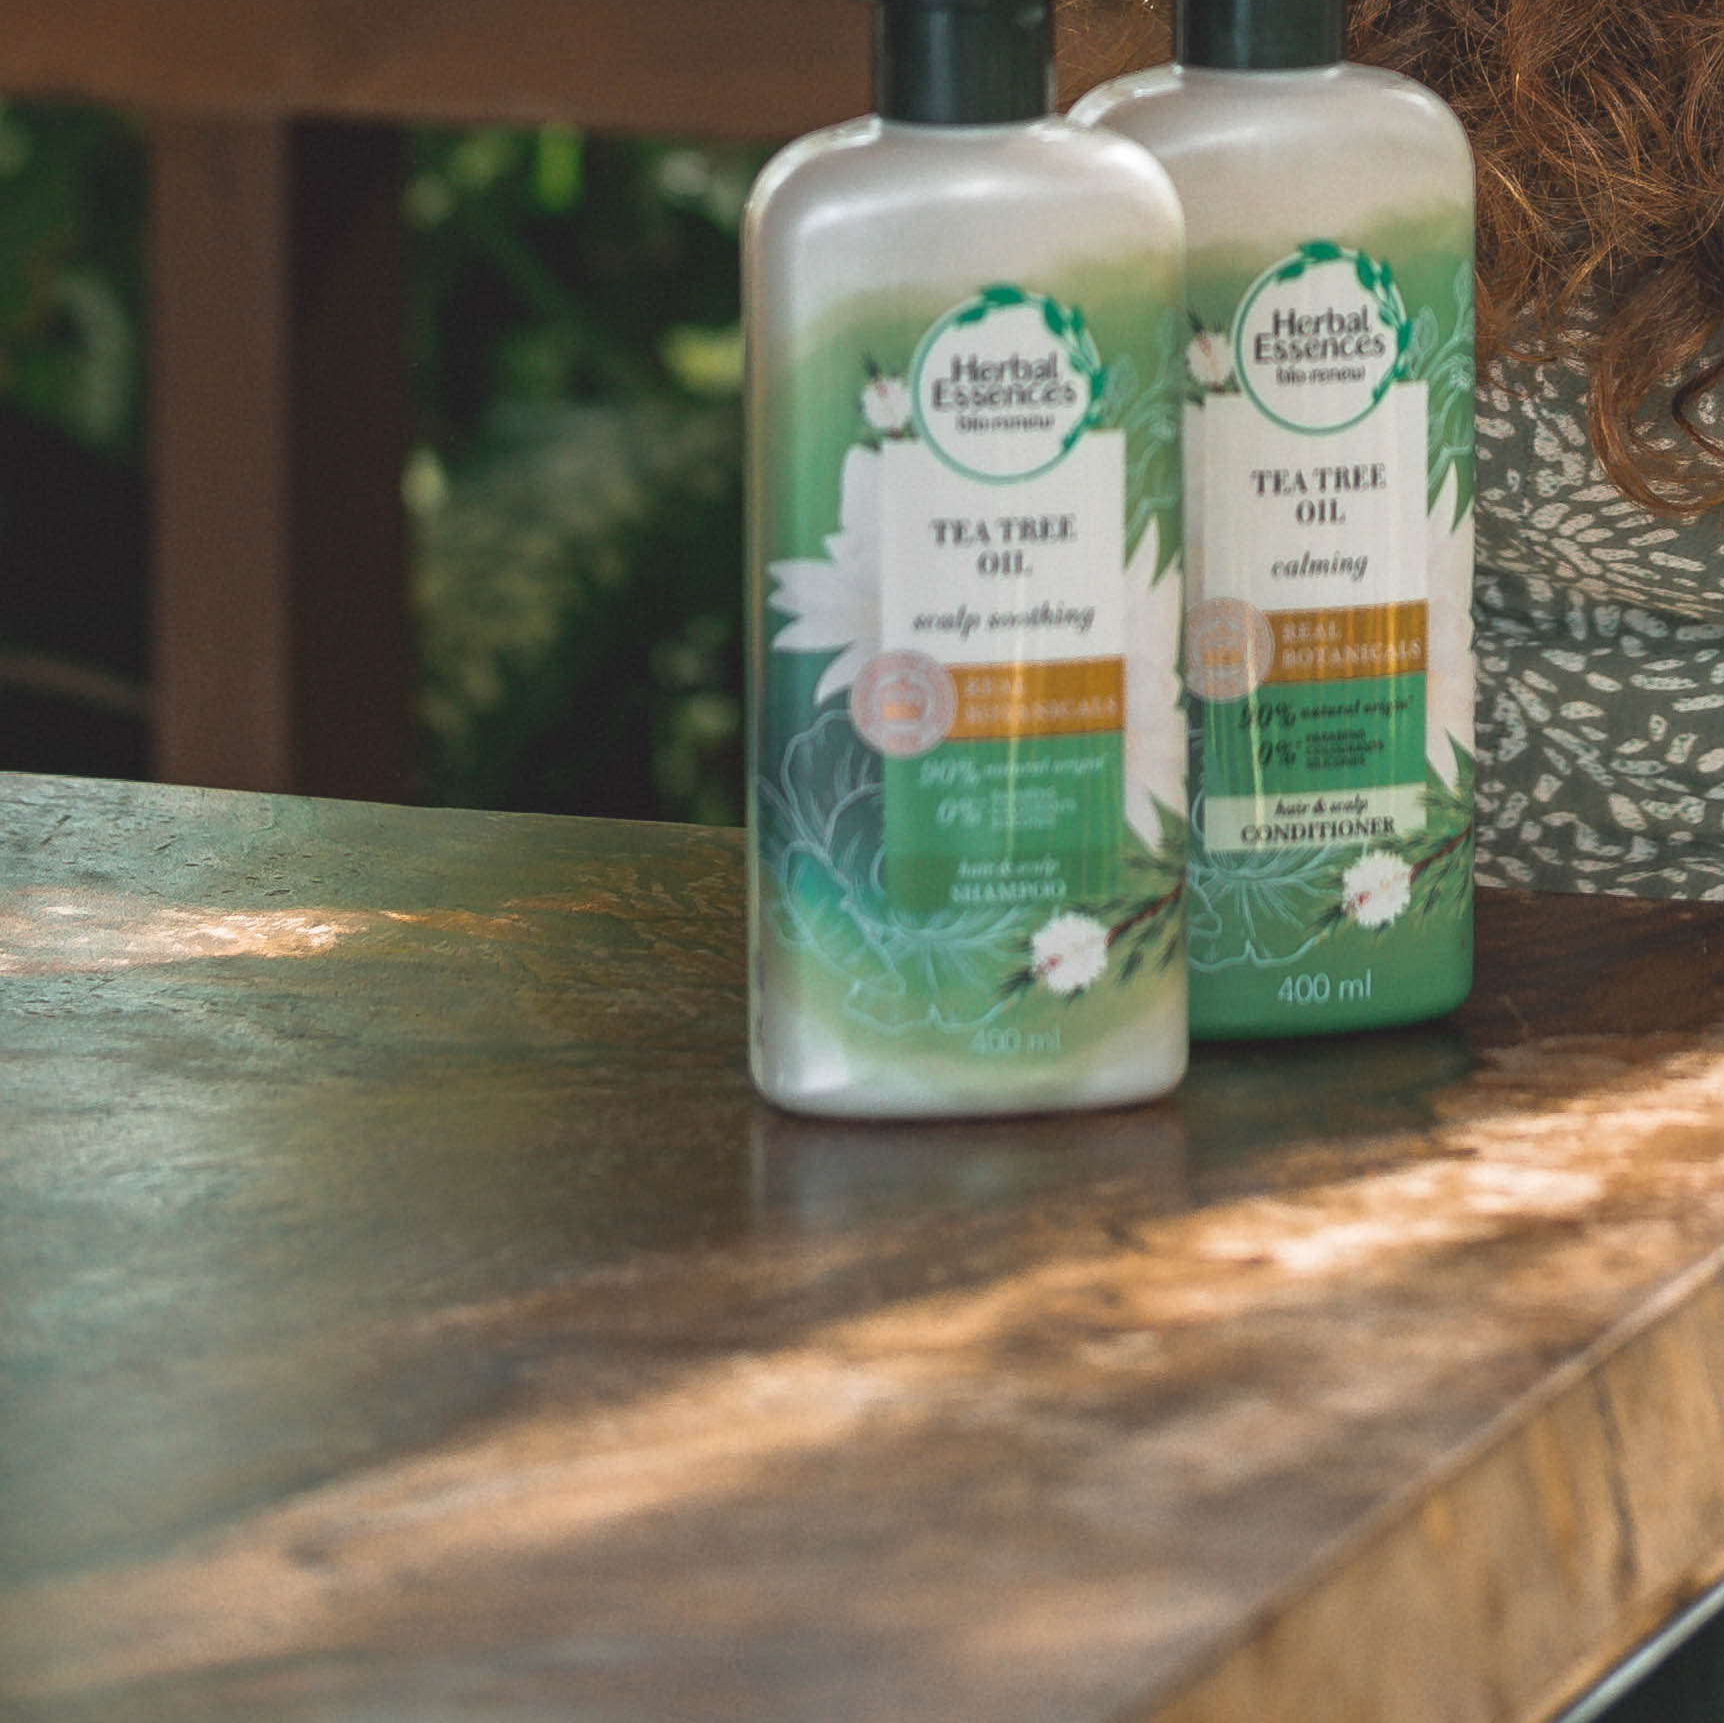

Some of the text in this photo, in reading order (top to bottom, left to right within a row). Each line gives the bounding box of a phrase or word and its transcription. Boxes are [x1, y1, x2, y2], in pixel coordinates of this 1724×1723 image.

[1272, 305, 1370, 337] Herbal
[1255, 333, 1386, 363] Essences
[951, 351, 1058, 383] Herbal
[931, 377, 1078, 411] Essences
[1250, 462, 1387, 497] TEA TREE
[1295, 498, 1346, 526] OIL
[929, 512, 1078, 547] TEA TREE
[976, 549, 1033, 577] OIL
[1271, 551, 1369, 582] calming
[912, 600, 1096, 642] scalp soothing
[1281, 619, 1342, 642] REAL
[1281, 637, 1424, 669] BOTANICALS
[1238, 701, 1297, 731] 90%
[1299, 698, 1362, 721] natural
[1257, 739, 1297, 768] 0%
[1274, 793, 1369, 817] hair & scalp
[1240, 815, 1396, 845] CONDITIONER
[951, 878, 1067, 903] SHAMPOO
[1277, 968, 1373, 1005] 400 ml
[1026, 1027, 1061, 1053] ml
